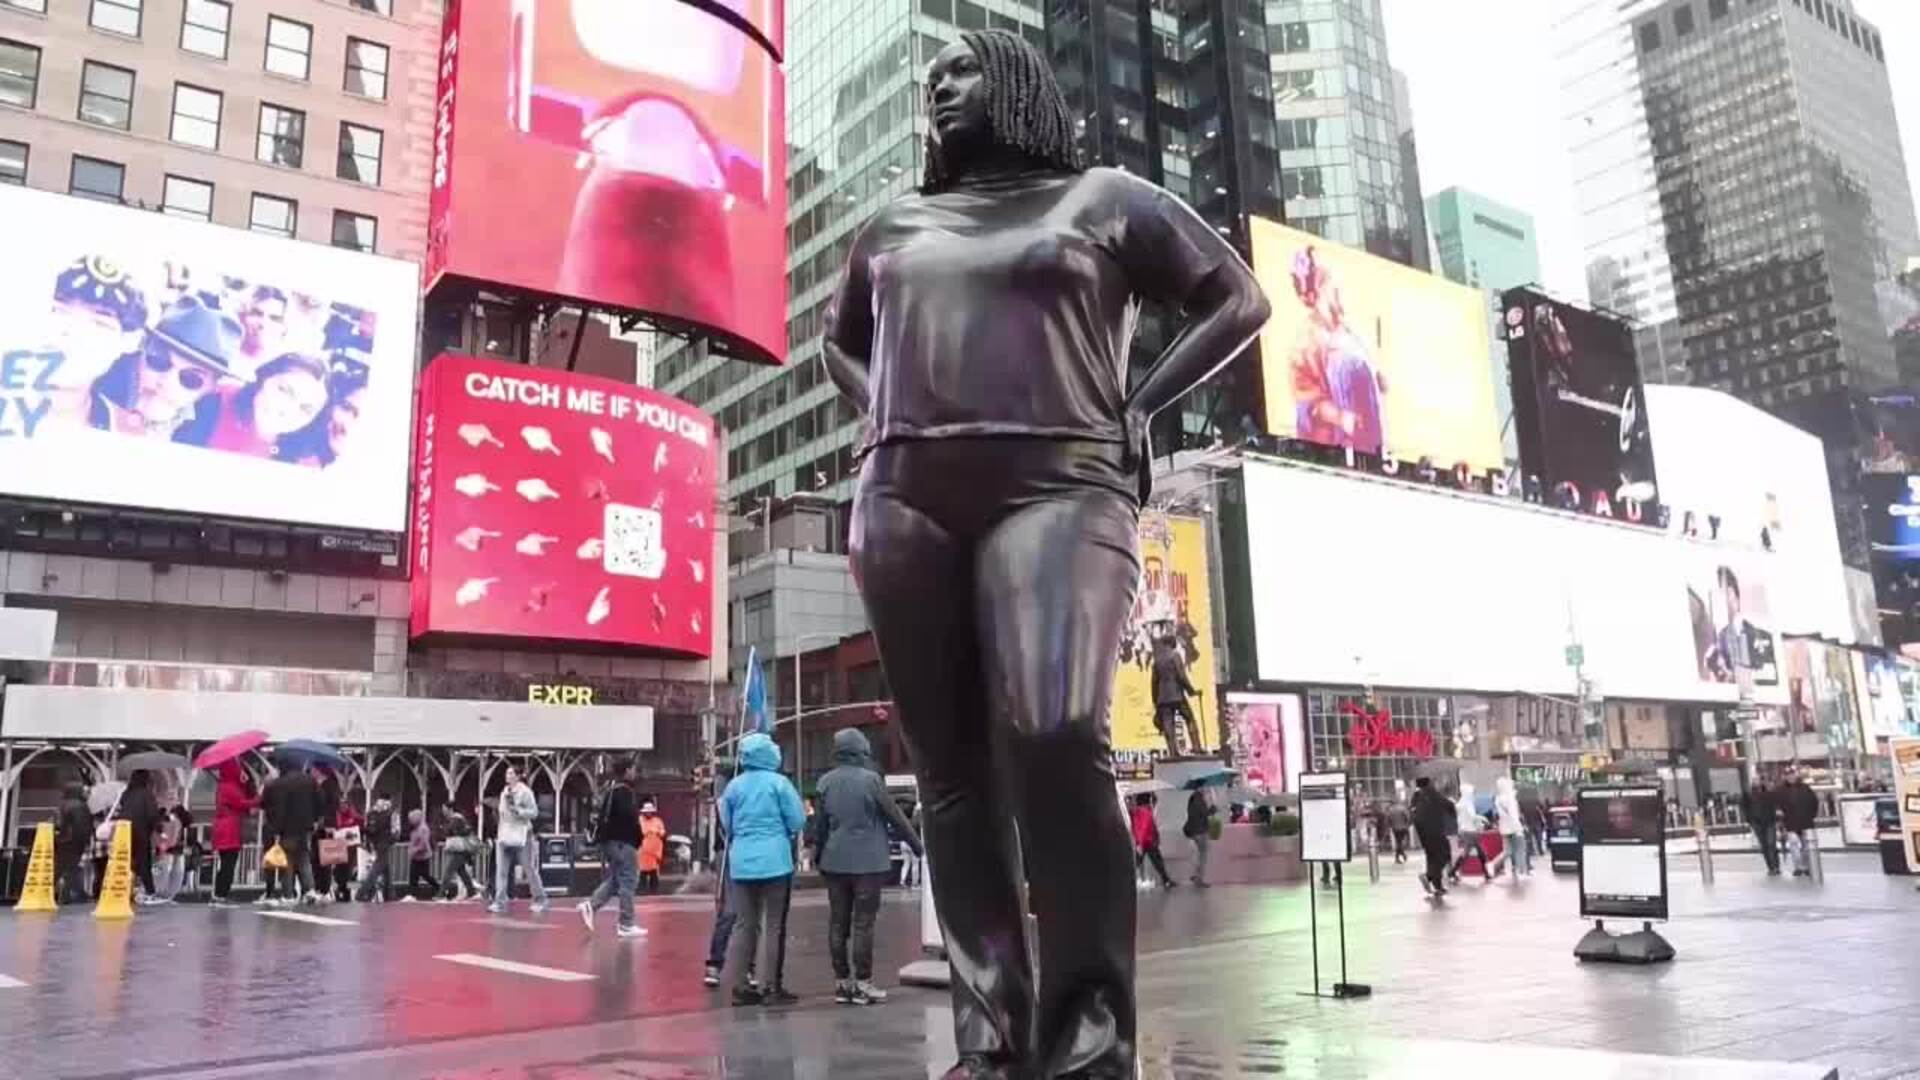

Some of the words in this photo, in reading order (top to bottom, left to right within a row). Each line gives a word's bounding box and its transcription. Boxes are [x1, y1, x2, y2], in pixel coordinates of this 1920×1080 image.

[465, 372, 560, 408] CATCH
[566, 387, 604, 415] ME
[610, 394, 632, 419] IF
[635, 402, 675, 433] YOU
[528, 684, 593, 707] EXPR
